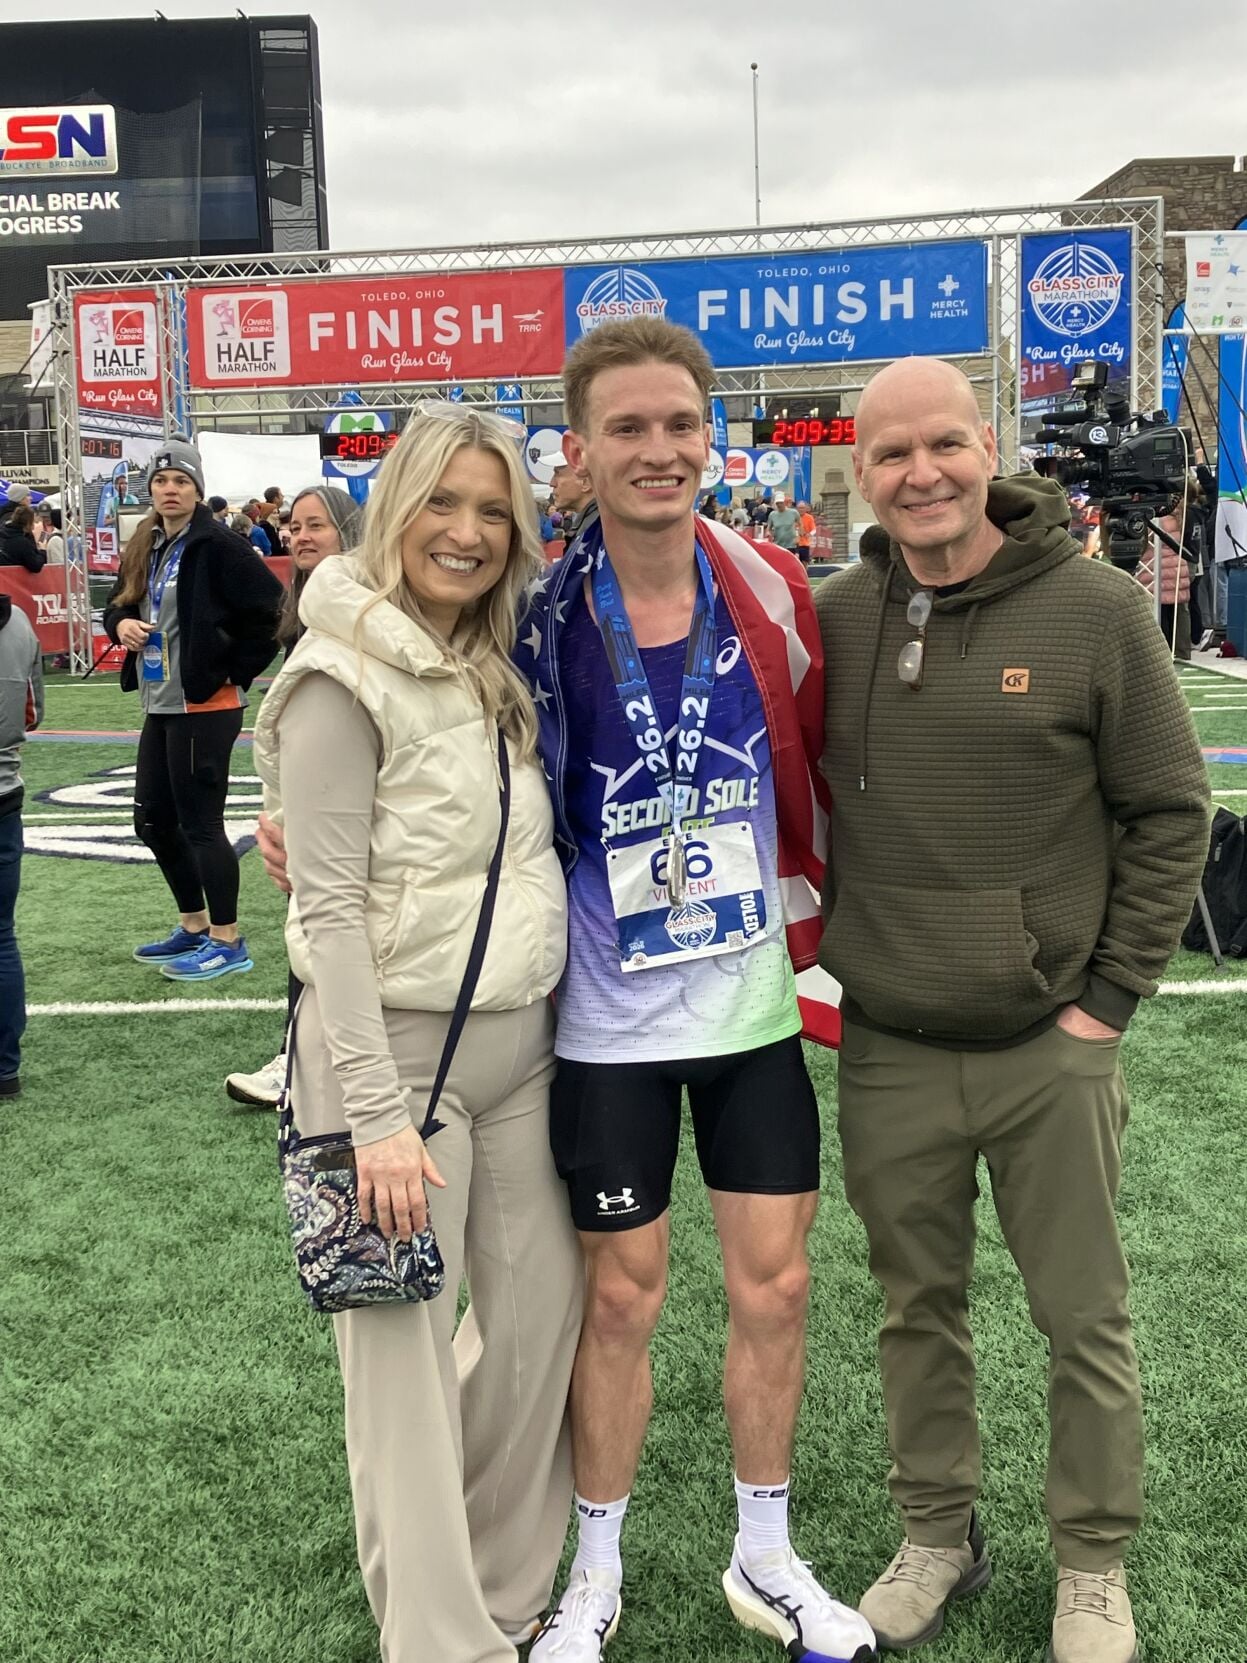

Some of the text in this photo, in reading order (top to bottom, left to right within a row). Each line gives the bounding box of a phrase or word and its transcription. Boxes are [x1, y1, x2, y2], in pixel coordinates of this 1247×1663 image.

[0, 113, 107, 160] SN
[49, 159, 108, 168] BROADBAND
[0, 191, 120, 212] CIAL BREAK
[0, 215, 82, 235] OGRESS
[757, 264, 851, 278] TOLEDO, OHIO
[1030, 275, 1121, 293] GLASS CITY
[361, 289, 445, 302] TOLEDO, OHIO
[698, 278, 914, 331] FINISH
[931, 300, 966, 310] MERCY
[1044, 289, 1109, 301] MARATHON
[578, 301, 666, 317] GLASS CITY
[930, 309, 969, 319] HEALTH
[308, 303, 503, 351] FINISH
[754, 329, 856, 354] Run Glass City
[93, 348, 146, 368] HALF
[217, 341, 275, 363] HALF
[361, 350, 453, 374] Run Glass City
[1060, 343, 1096, 365] Glass
[1098, 342, 1124, 362] City
[92, 367, 148, 378] MARATHON
[217, 362, 277, 373] MARATHON
[108, 388, 135, 407] Glass
[137, 388, 158, 407] City
[0, 469, 32, 478] LLIVAN
[625, 694, 670, 773] 26.2
[677, 696, 709, 774] 26.2
[704, 776, 759, 815] SOLE
[650, 841, 713, 886] 66
[653, 879, 717, 902] VIENT
[666, 917, 694, 930] GLASS
[739, 892, 760, 938] TOLED
[753, 1489, 789, 1498] ce
